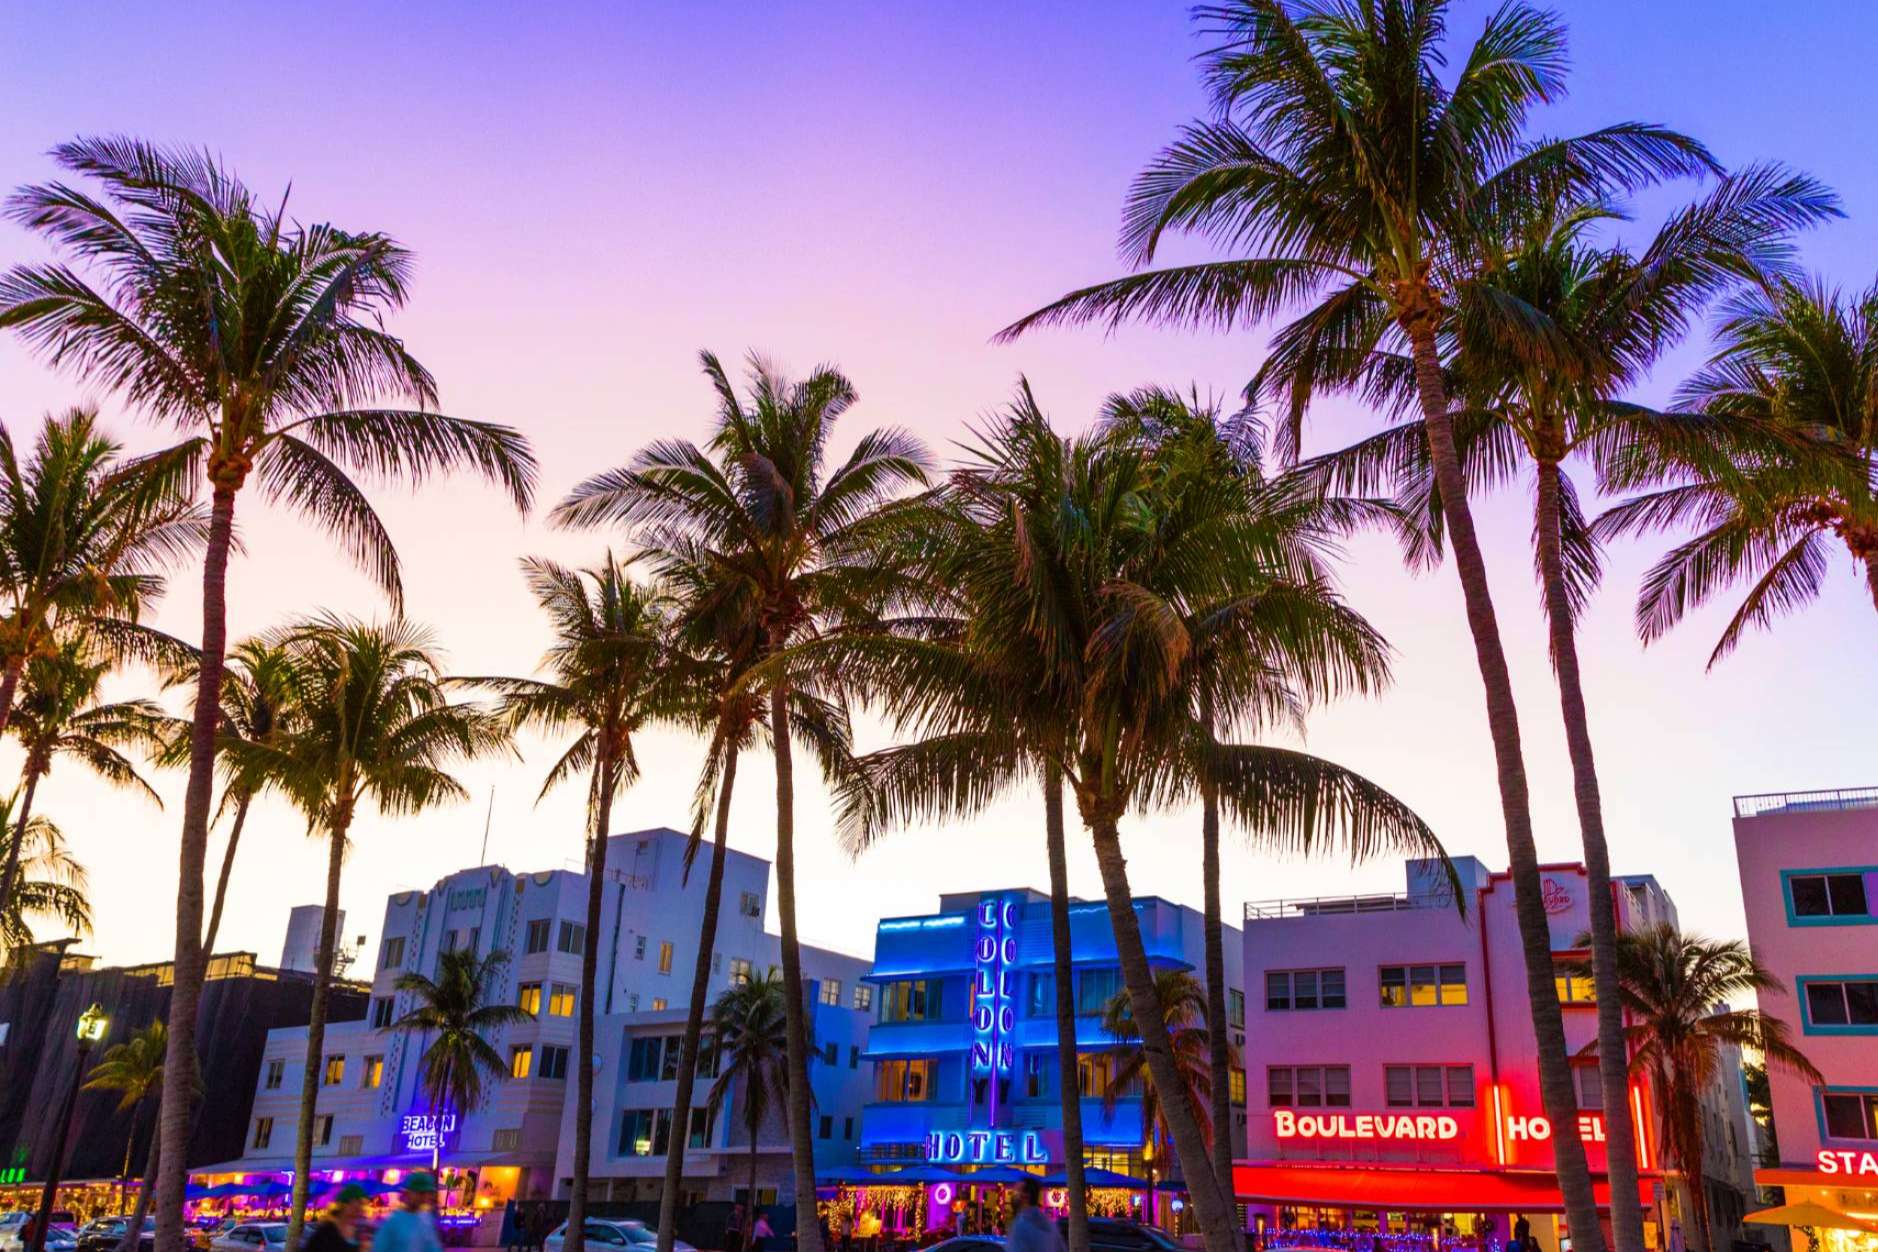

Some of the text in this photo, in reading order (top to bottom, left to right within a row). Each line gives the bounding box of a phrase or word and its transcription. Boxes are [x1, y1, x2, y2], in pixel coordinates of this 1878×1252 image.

[972, 901, 997, 1105] COLONY
[1274, 1110, 1606, 1142] BOULEVARD HOEL
[925, 1130, 1049, 1163] HOTEL
[1818, 1150, 1878, 1175] STA
